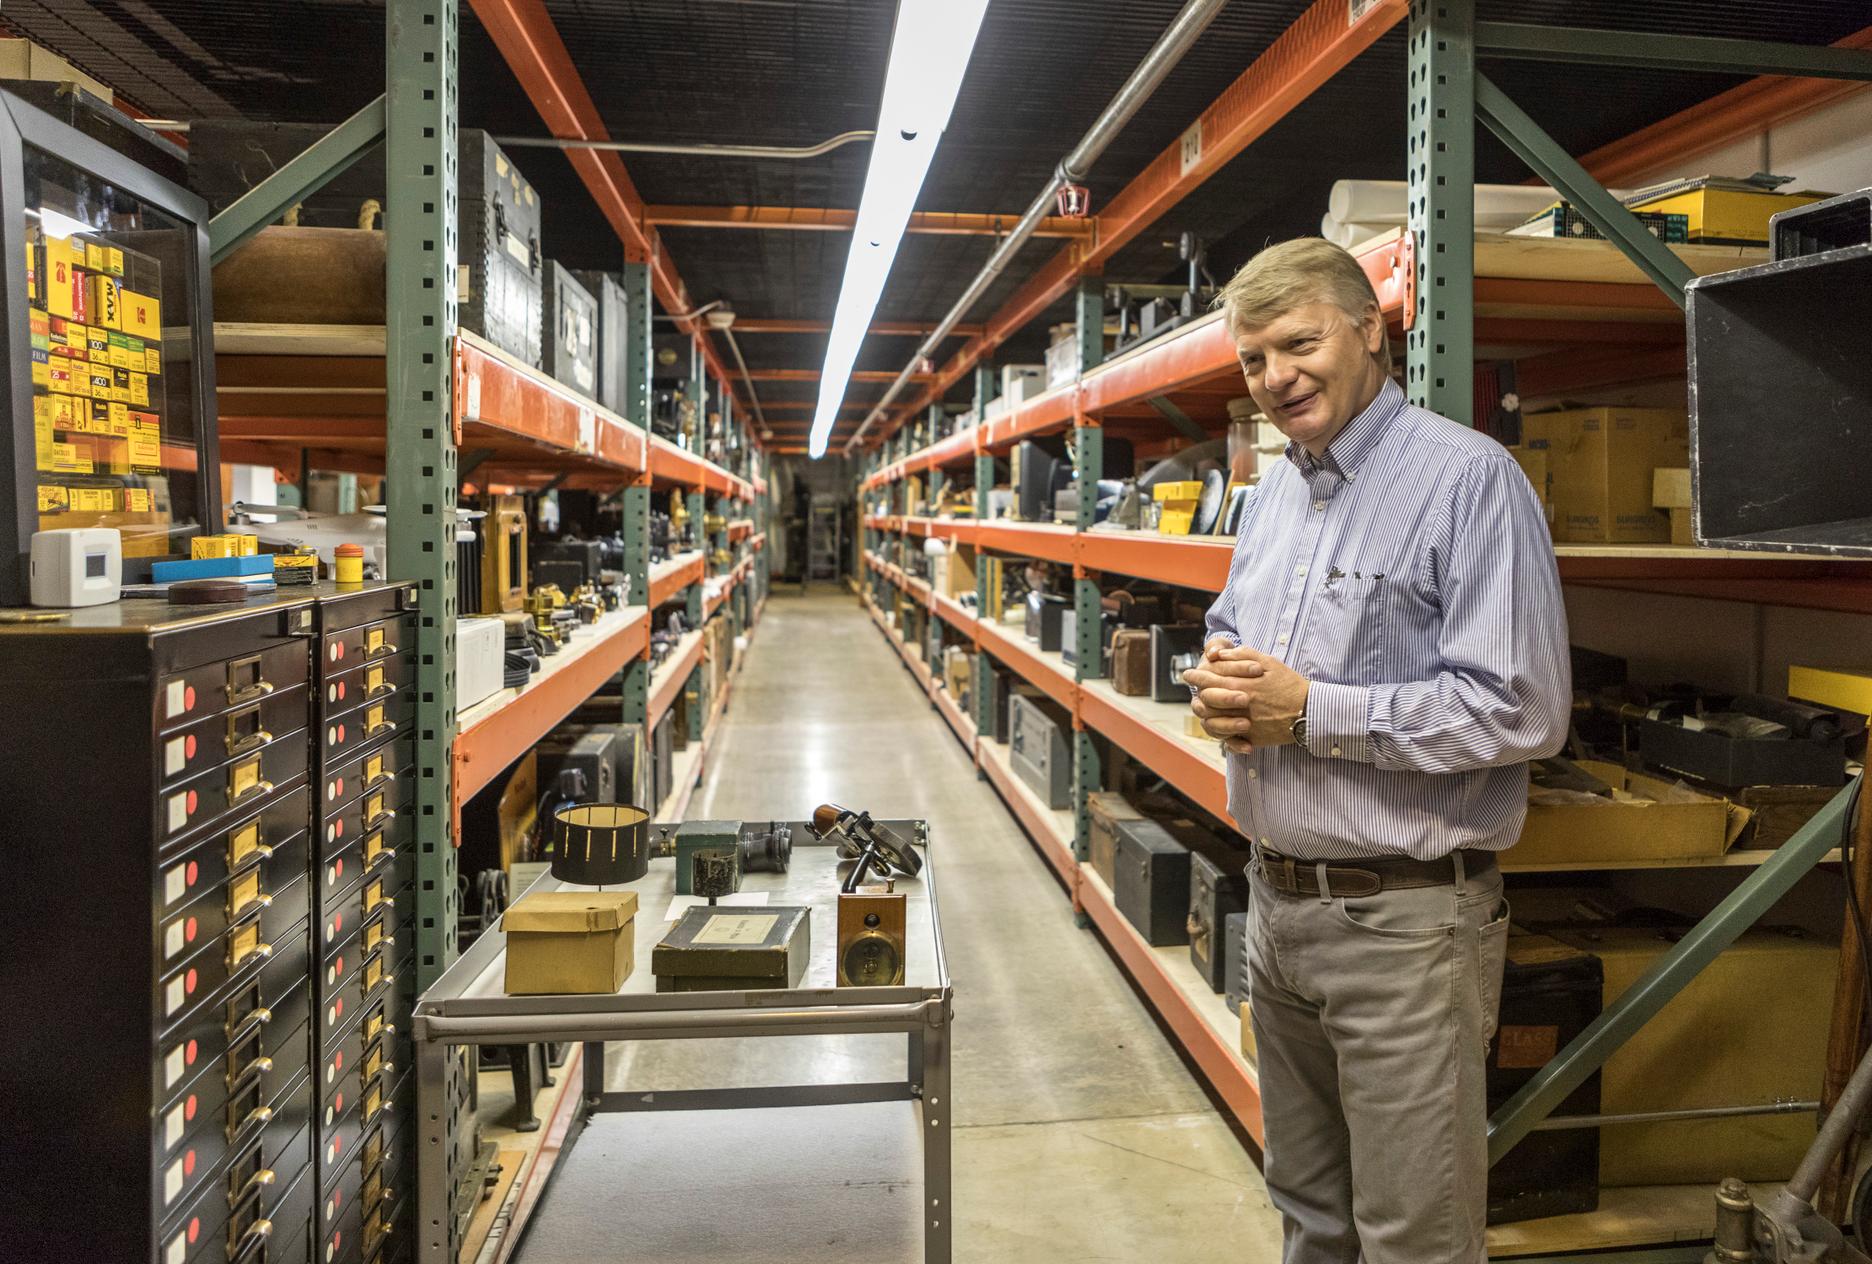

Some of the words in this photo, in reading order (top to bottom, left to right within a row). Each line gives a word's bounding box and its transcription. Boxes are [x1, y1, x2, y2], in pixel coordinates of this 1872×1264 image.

[106, 281, 115, 323] MAX
[91, 340, 103, 350] 100
[32, 350, 47, 361] FILM
